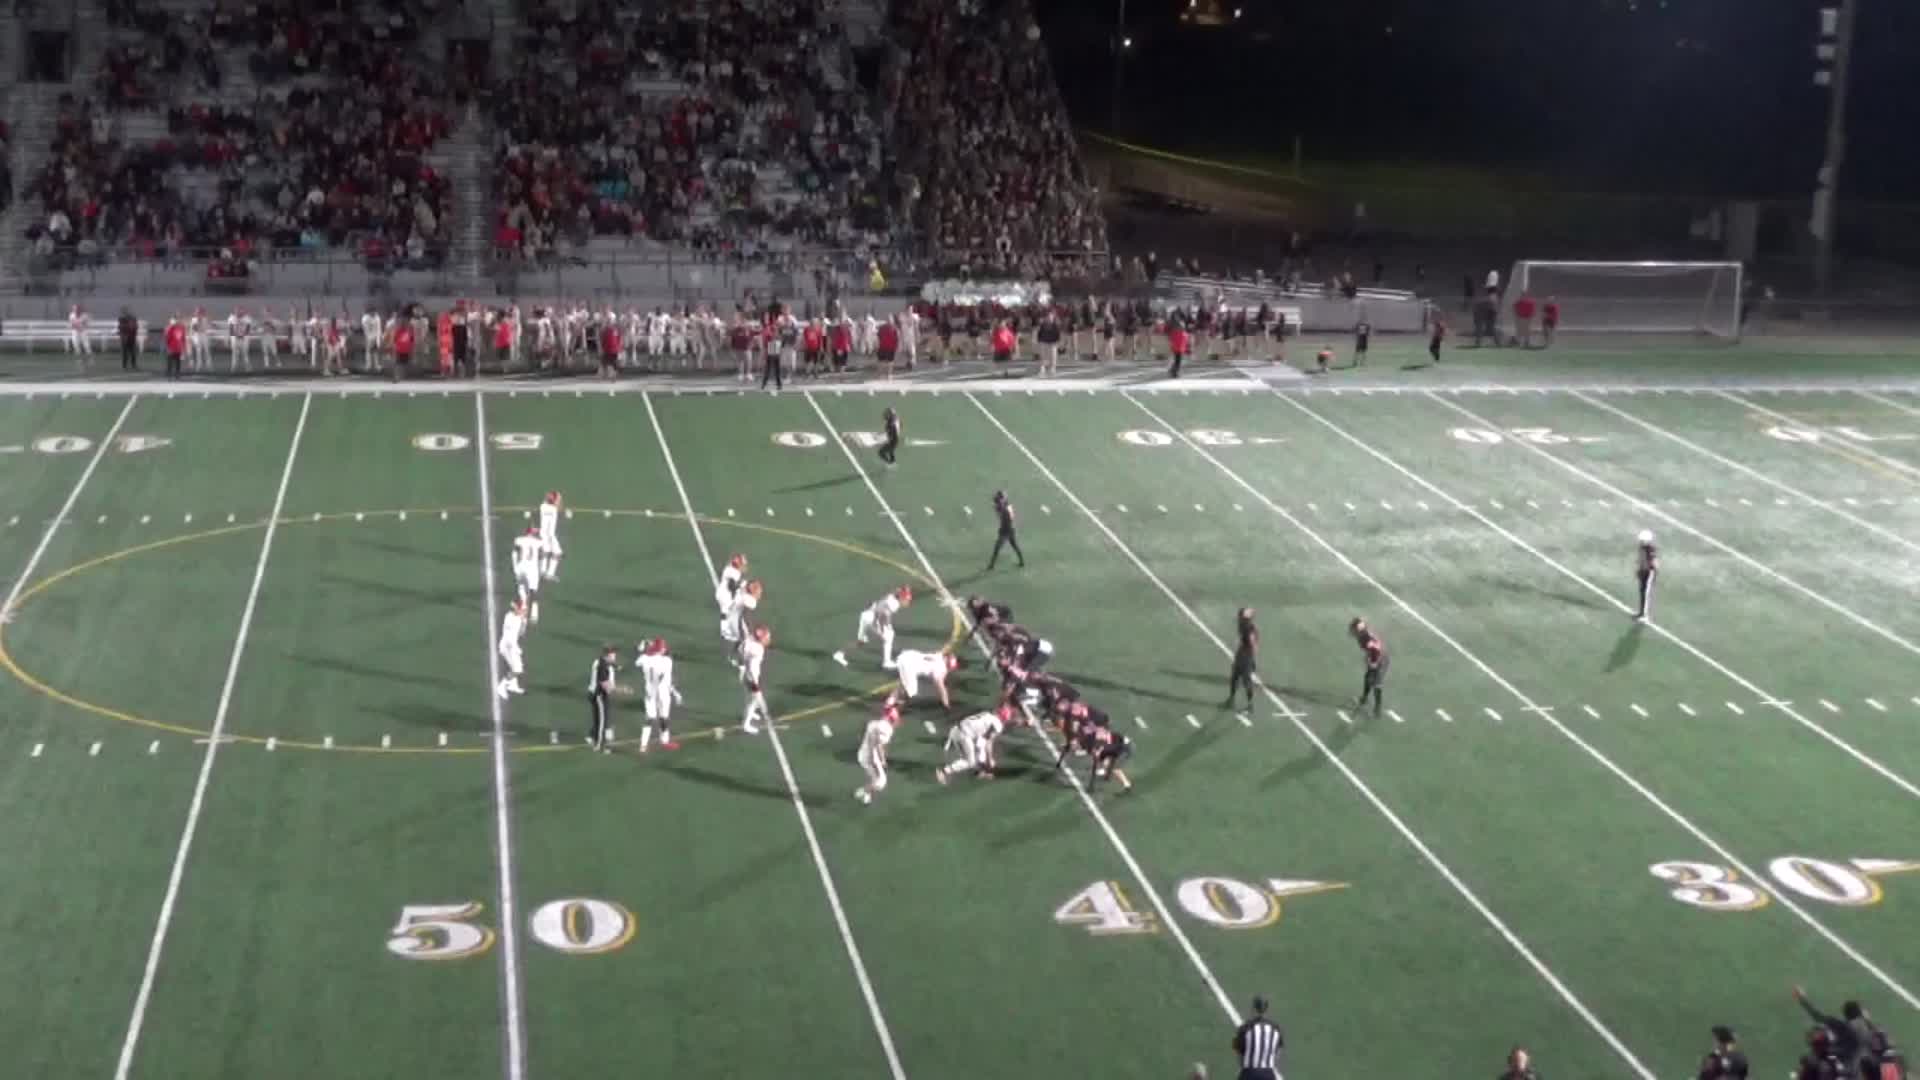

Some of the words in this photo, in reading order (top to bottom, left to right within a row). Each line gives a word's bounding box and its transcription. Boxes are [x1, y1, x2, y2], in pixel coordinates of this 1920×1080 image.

[1053, 877, 1281, 935] 40
[1648, 857, 1884, 911] 30
[385, 898, 637, 960] 50
